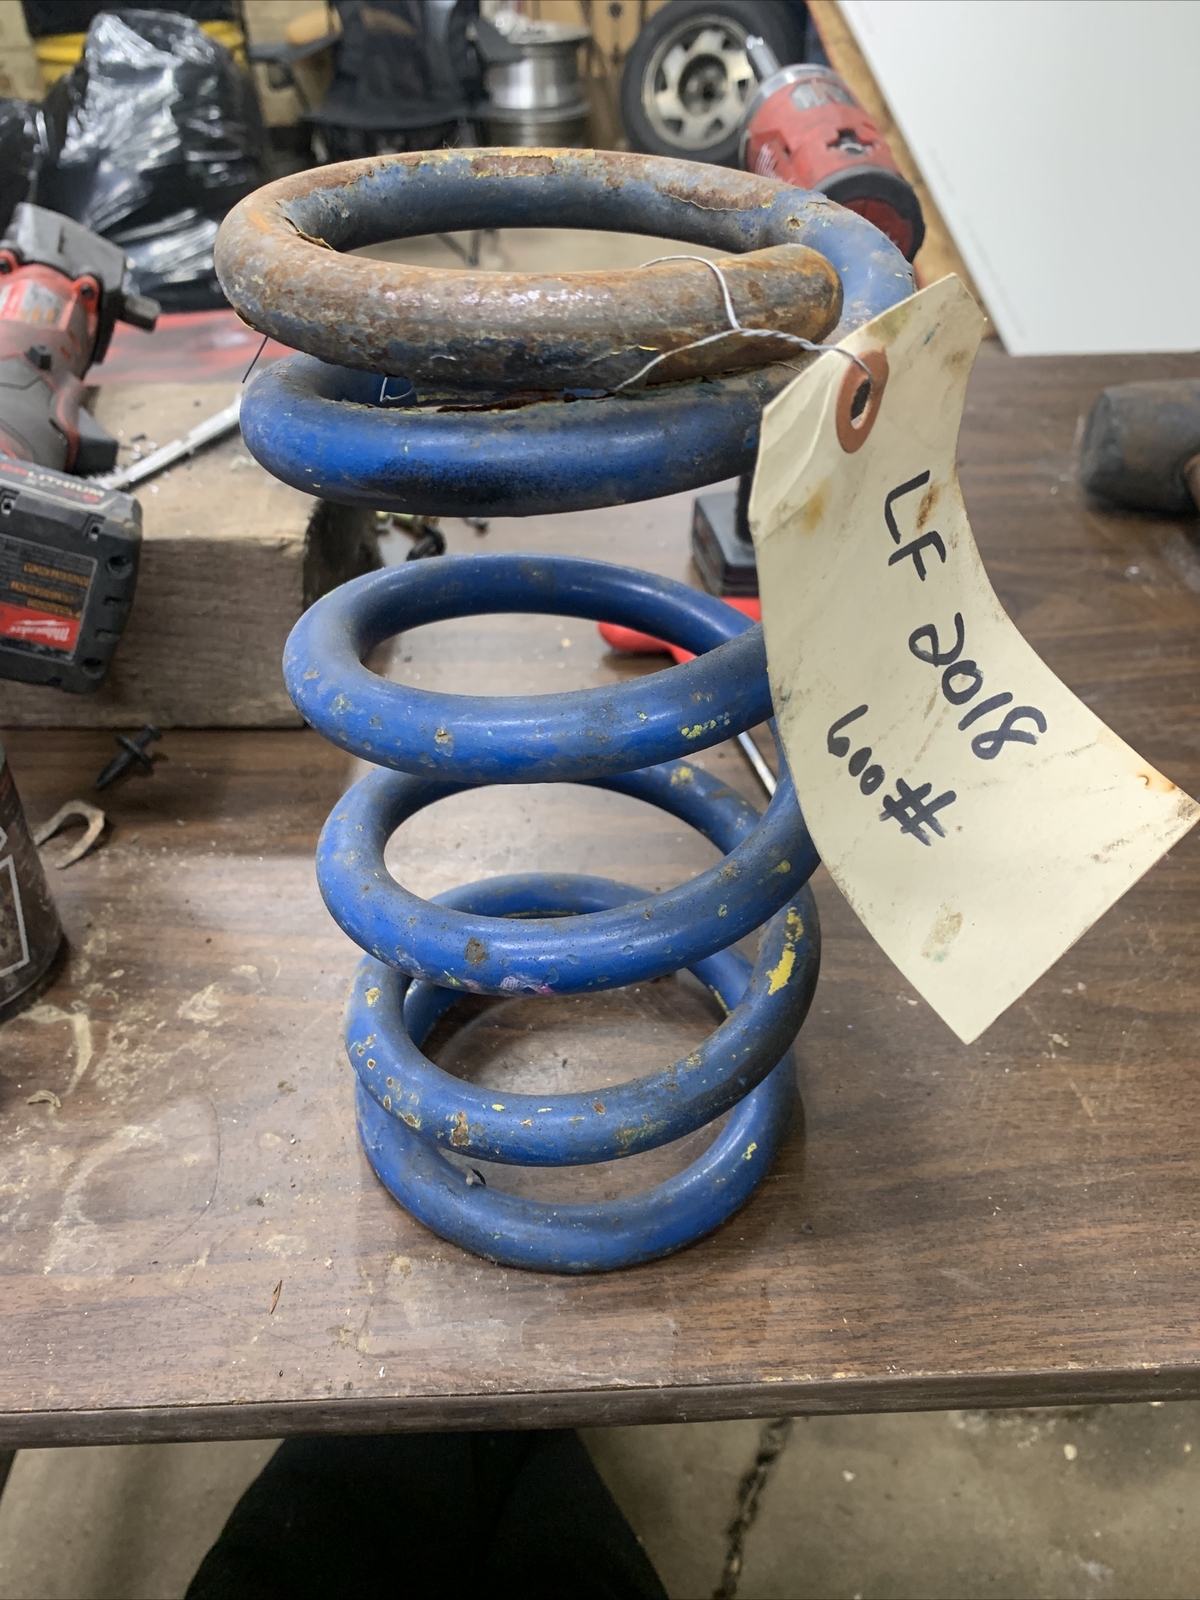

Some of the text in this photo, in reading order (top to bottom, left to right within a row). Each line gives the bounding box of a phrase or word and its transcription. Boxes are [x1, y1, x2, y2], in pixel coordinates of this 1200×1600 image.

[883, 469, 1047, 760] LF 2018
[827, 704, 957, 846] 600#
